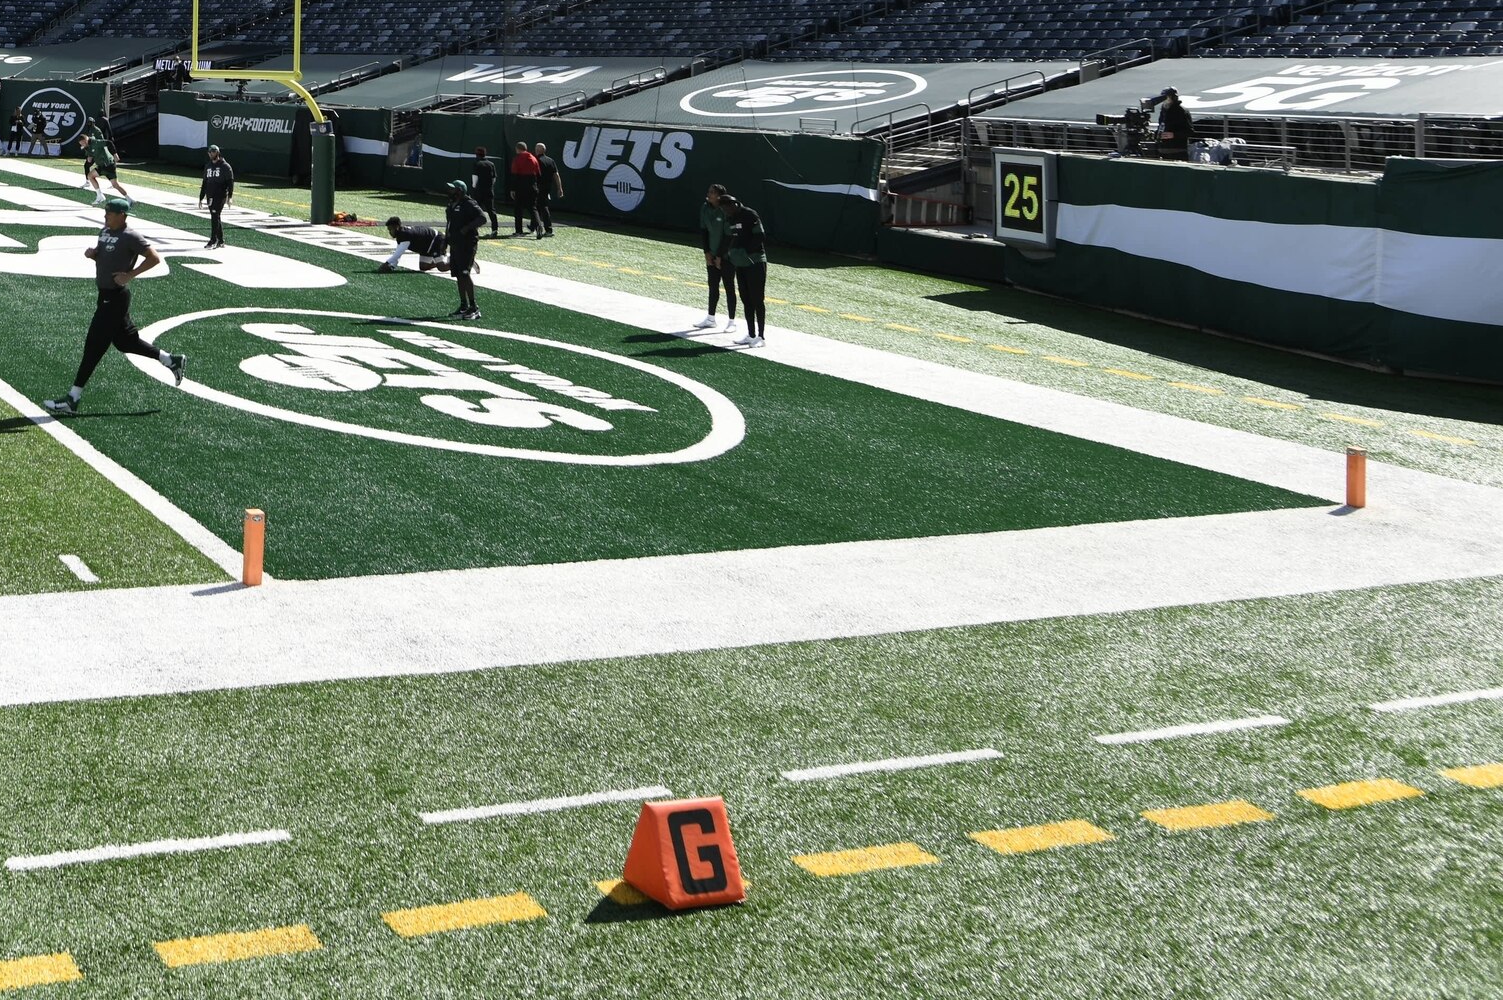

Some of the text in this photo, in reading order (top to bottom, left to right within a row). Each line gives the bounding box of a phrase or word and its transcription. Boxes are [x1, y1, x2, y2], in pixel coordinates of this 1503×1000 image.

[155, 59, 176, 70] METLI
[445, 63, 603, 84] VISA
[1277, 63, 1463, 76] verizon
[32, 101, 71, 110] NEW YORK
[1178, 76, 1401, 111] 5G
[222, 115, 246, 132] PLAY
[562, 125, 694, 180] JETS
[1004, 173, 1039, 220] 25
[239, 322, 615, 431] JETS
[668, 809, 727, 895] G
